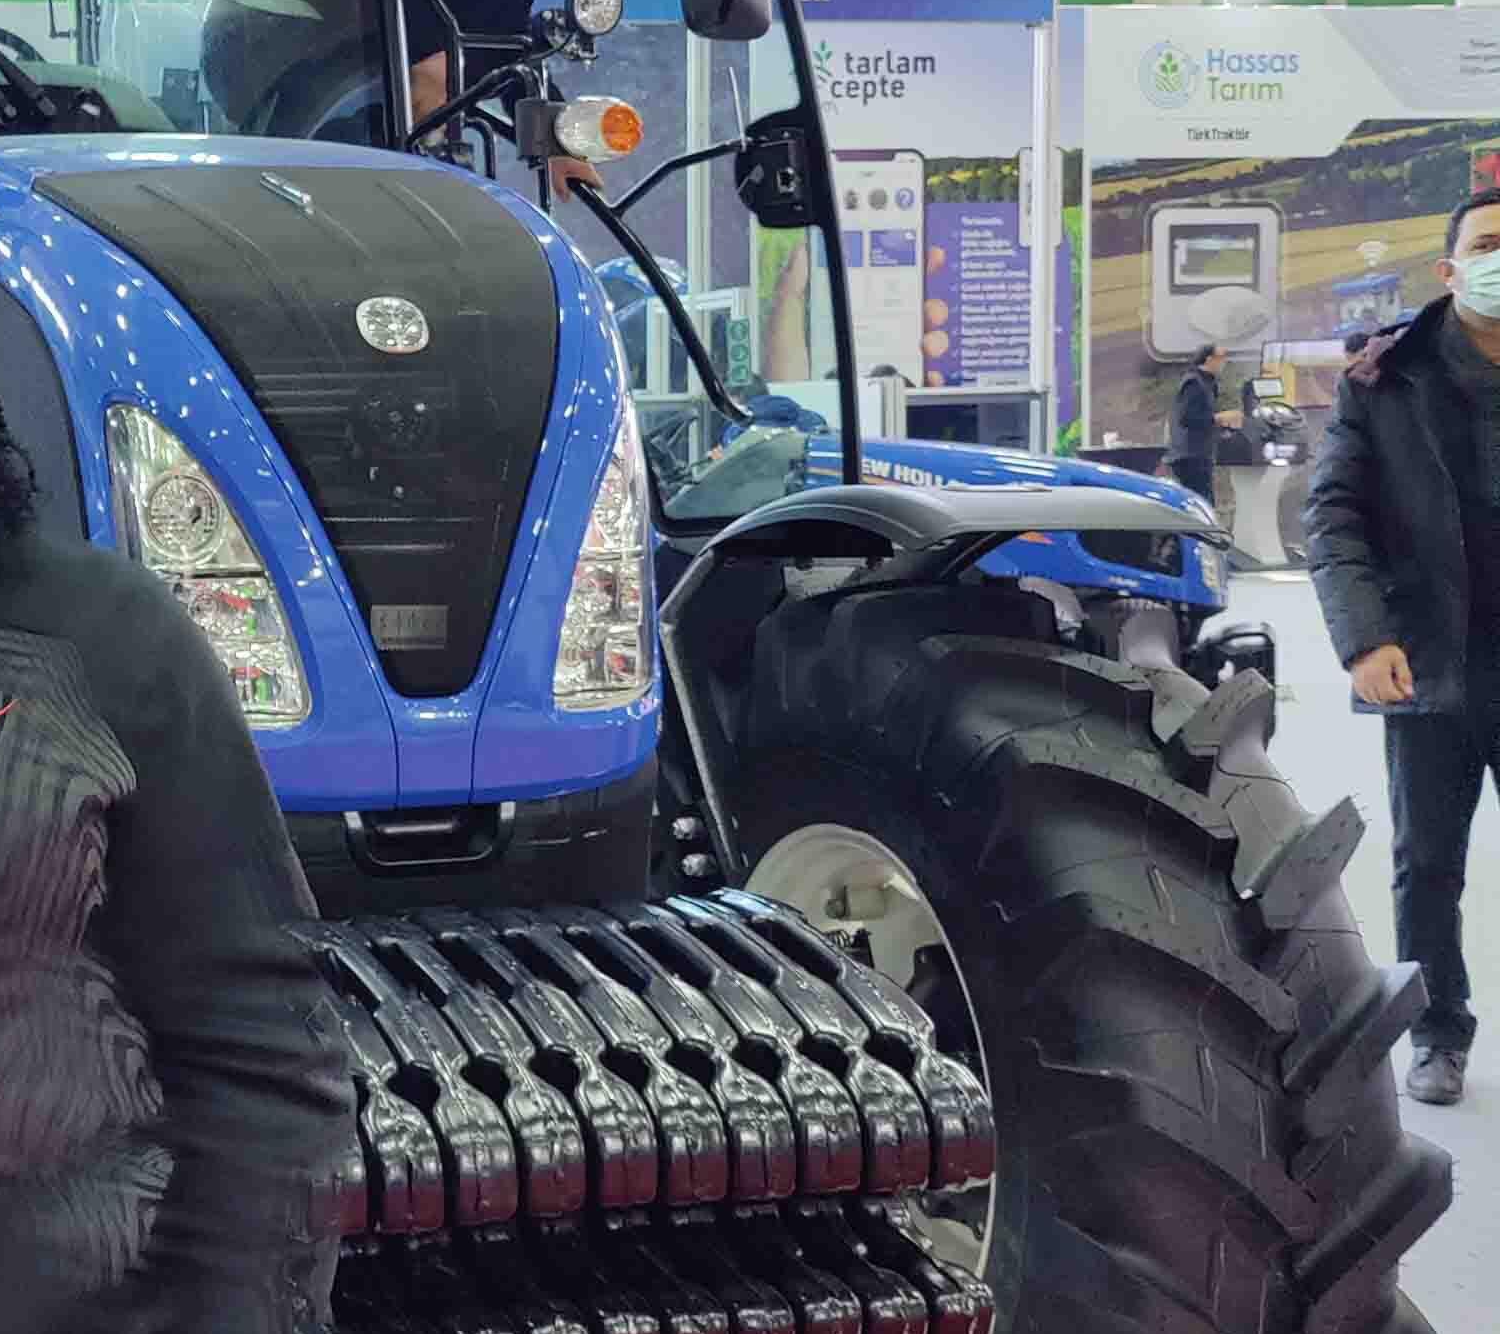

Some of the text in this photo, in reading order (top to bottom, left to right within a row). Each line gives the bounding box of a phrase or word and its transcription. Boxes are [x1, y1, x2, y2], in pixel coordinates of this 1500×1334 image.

[844, 51, 936, 75] tarlam
[1205, 48, 1300, 74] Hassas
[830, 74, 906, 105] cepte
[1206, 76, 1284, 101] Tarım
